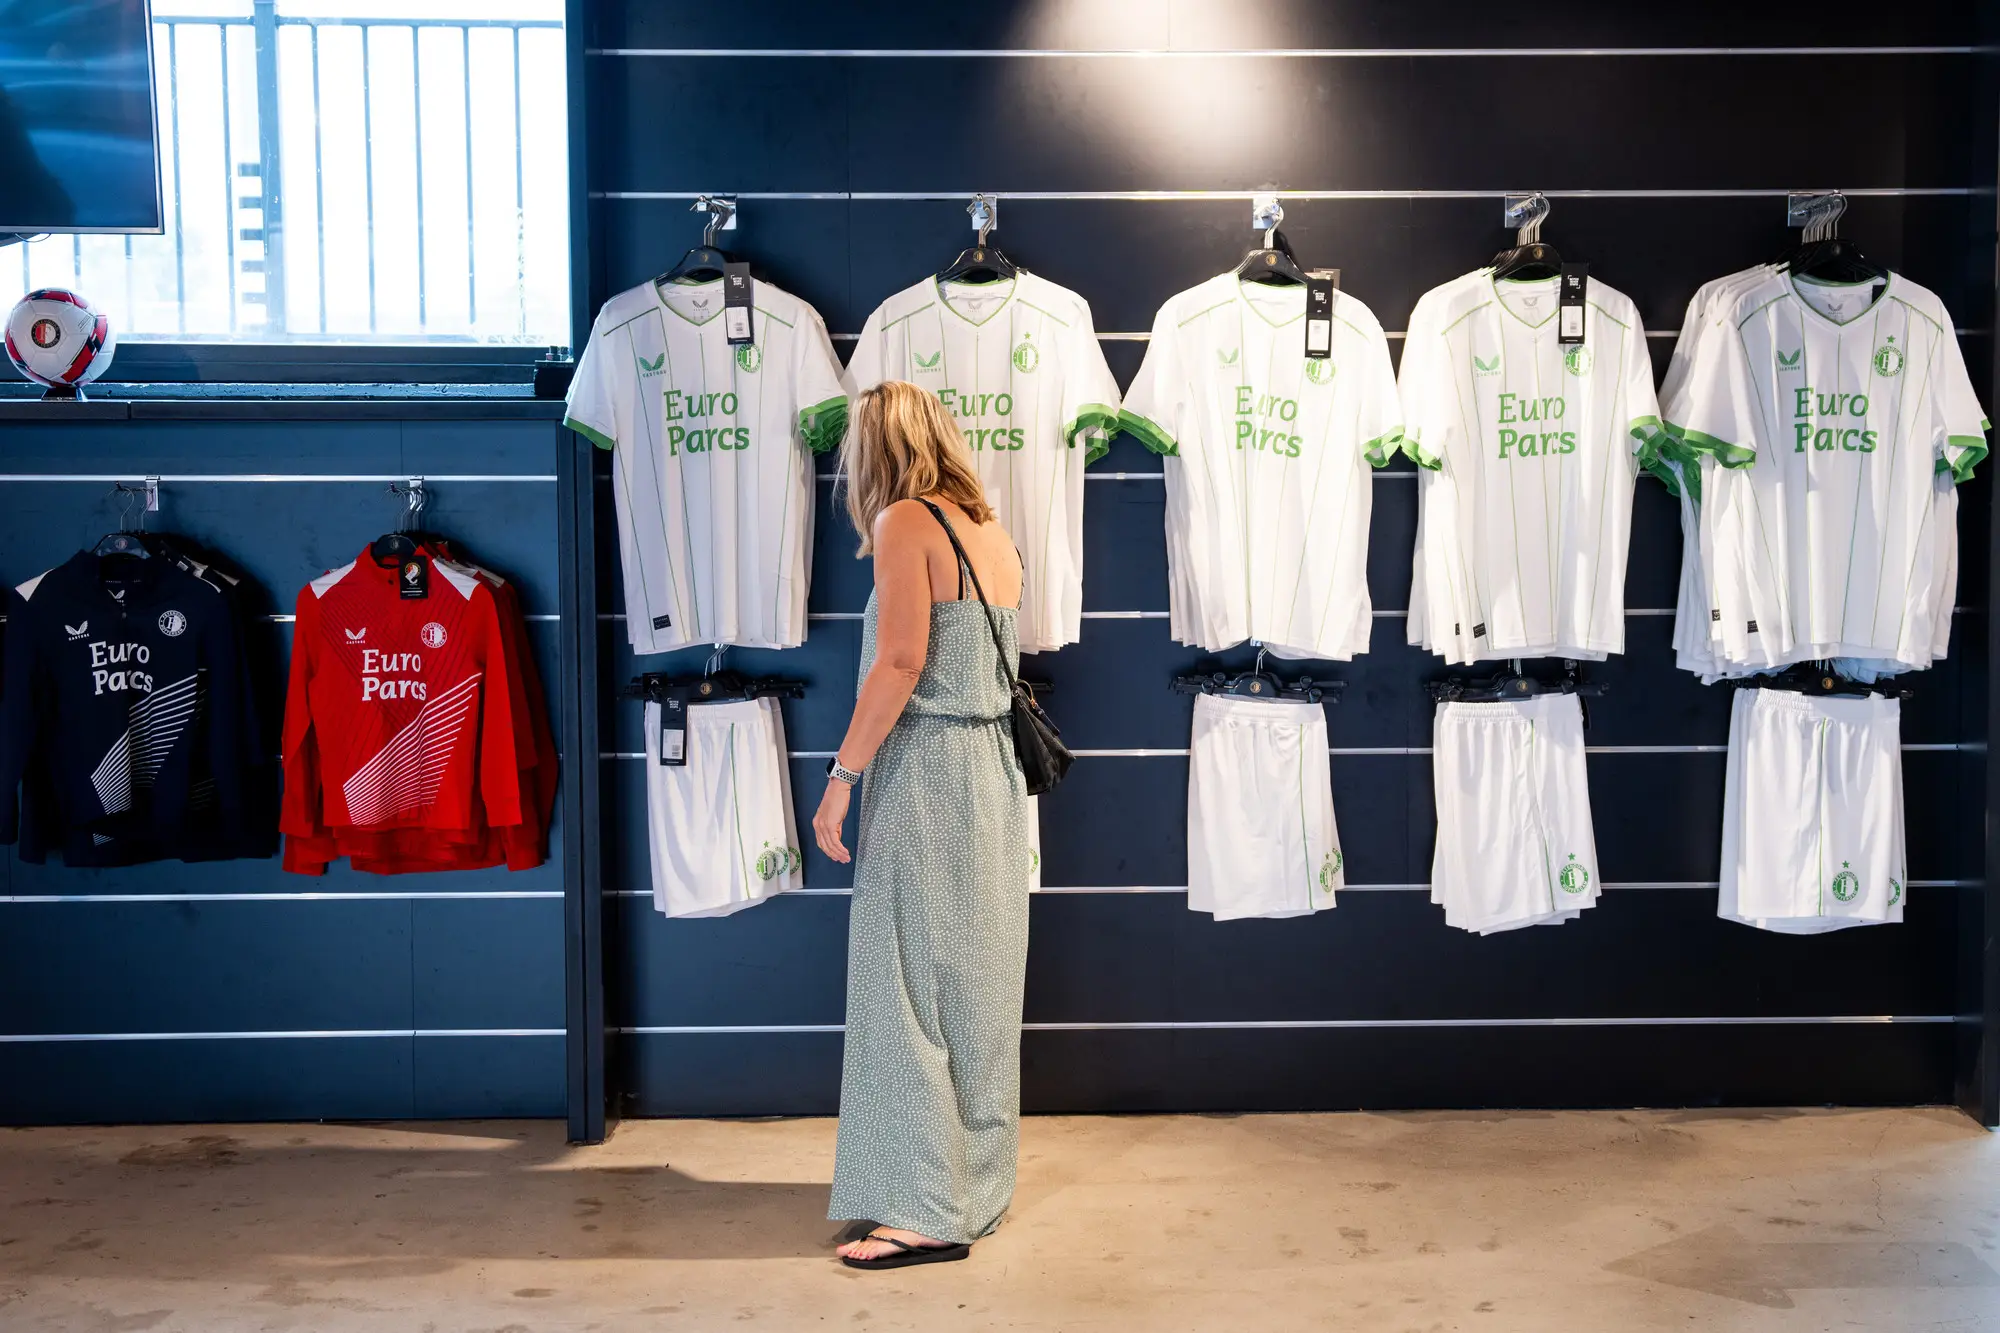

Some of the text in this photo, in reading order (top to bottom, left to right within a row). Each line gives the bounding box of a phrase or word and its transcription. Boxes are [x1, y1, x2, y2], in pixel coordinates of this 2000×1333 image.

[663, 389, 738, 421] Euro
[937, 388, 1013, 418] Euro
[1498, 392, 1566, 424] Euro
[1794, 387, 1869, 418] Euro
[667, 425, 750, 456] Parcs
[1794, 423, 1878, 453] Parcs
[88, 641, 150, 668] Euro
[362, 649, 421, 674] Euro
[361, 677, 427, 702] Parcs
